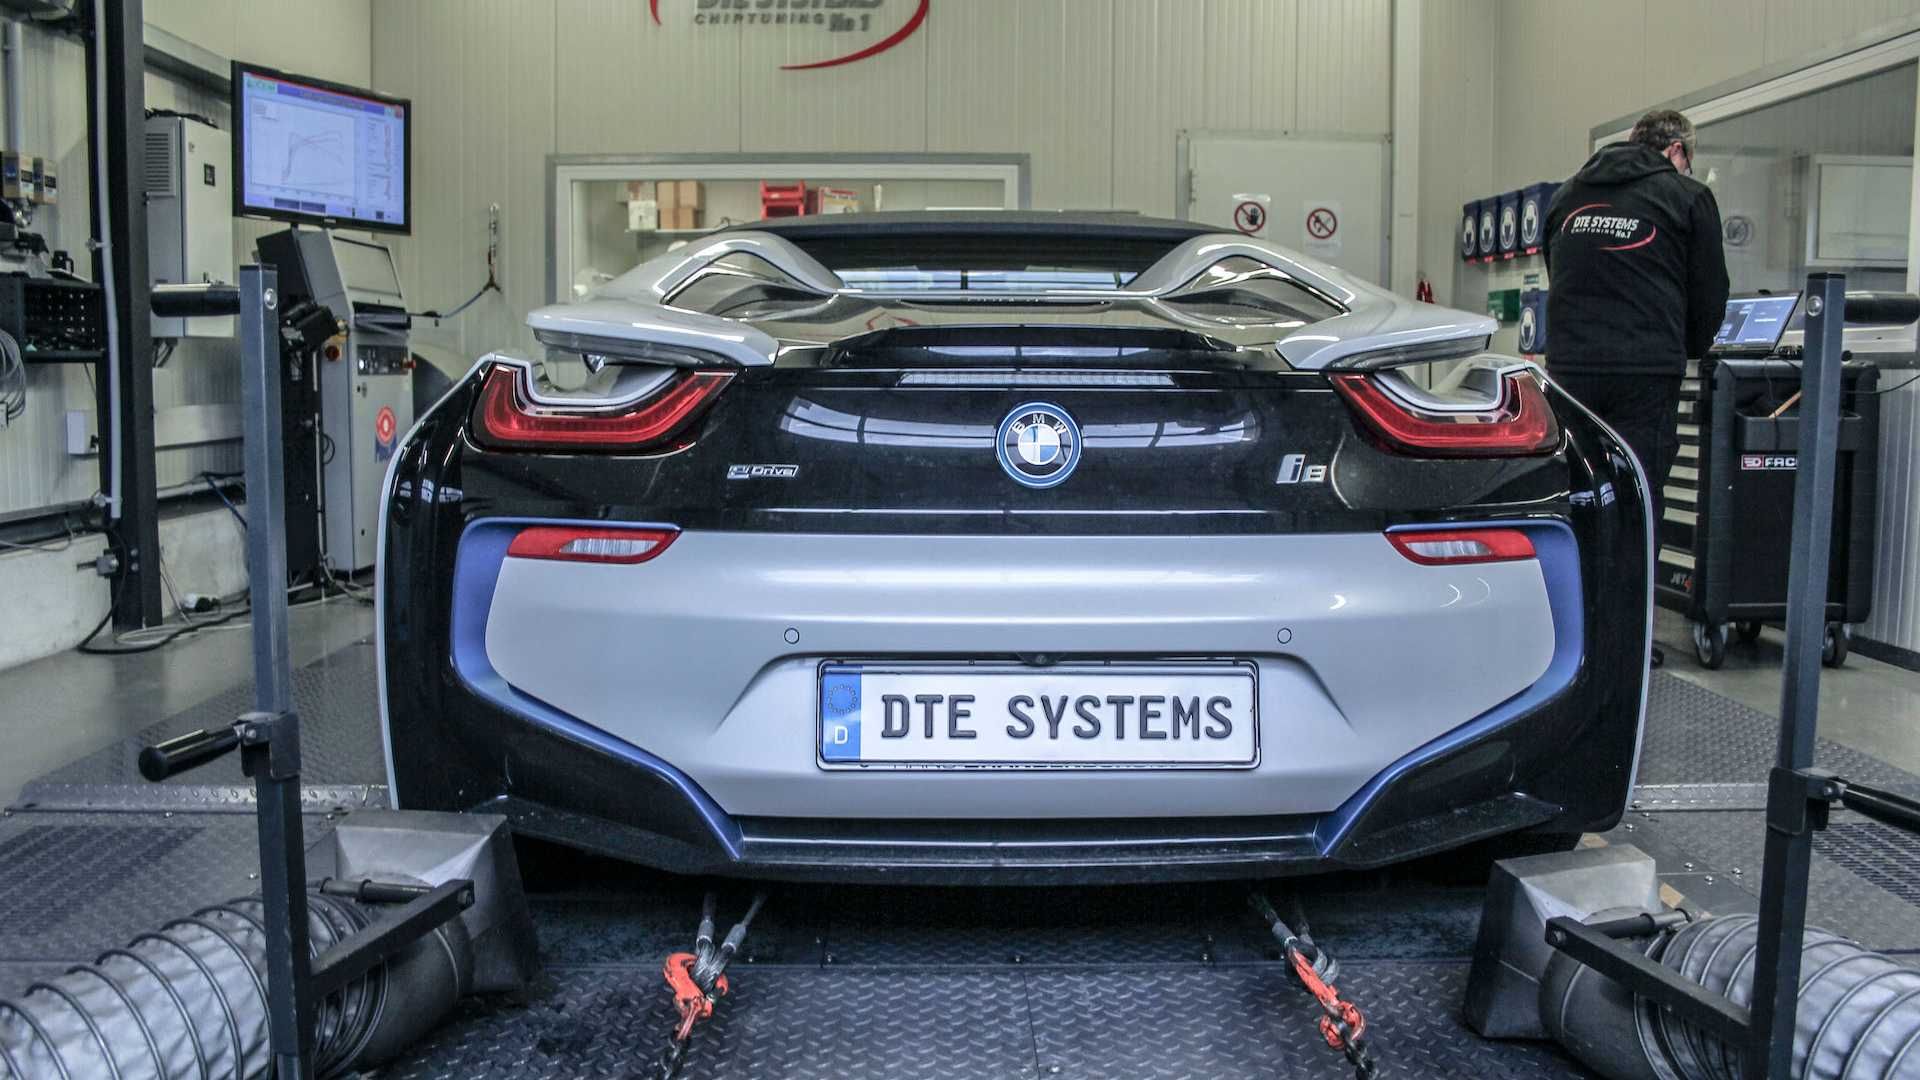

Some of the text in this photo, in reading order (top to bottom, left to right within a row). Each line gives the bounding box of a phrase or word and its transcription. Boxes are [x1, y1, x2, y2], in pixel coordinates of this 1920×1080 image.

[694, 13, 825, 25] CHIPTUNING
[1573, 215, 1639, 231] DTE SYSTEMS
[1011, 413, 1067, 435] BMW
[1276, 454, 1328, 483] i8
[1765, 457, 1797, 467] FAC
[880, 694, 1233, 741] DTE SYSTEMS
[833, 727, 848, 745] D
